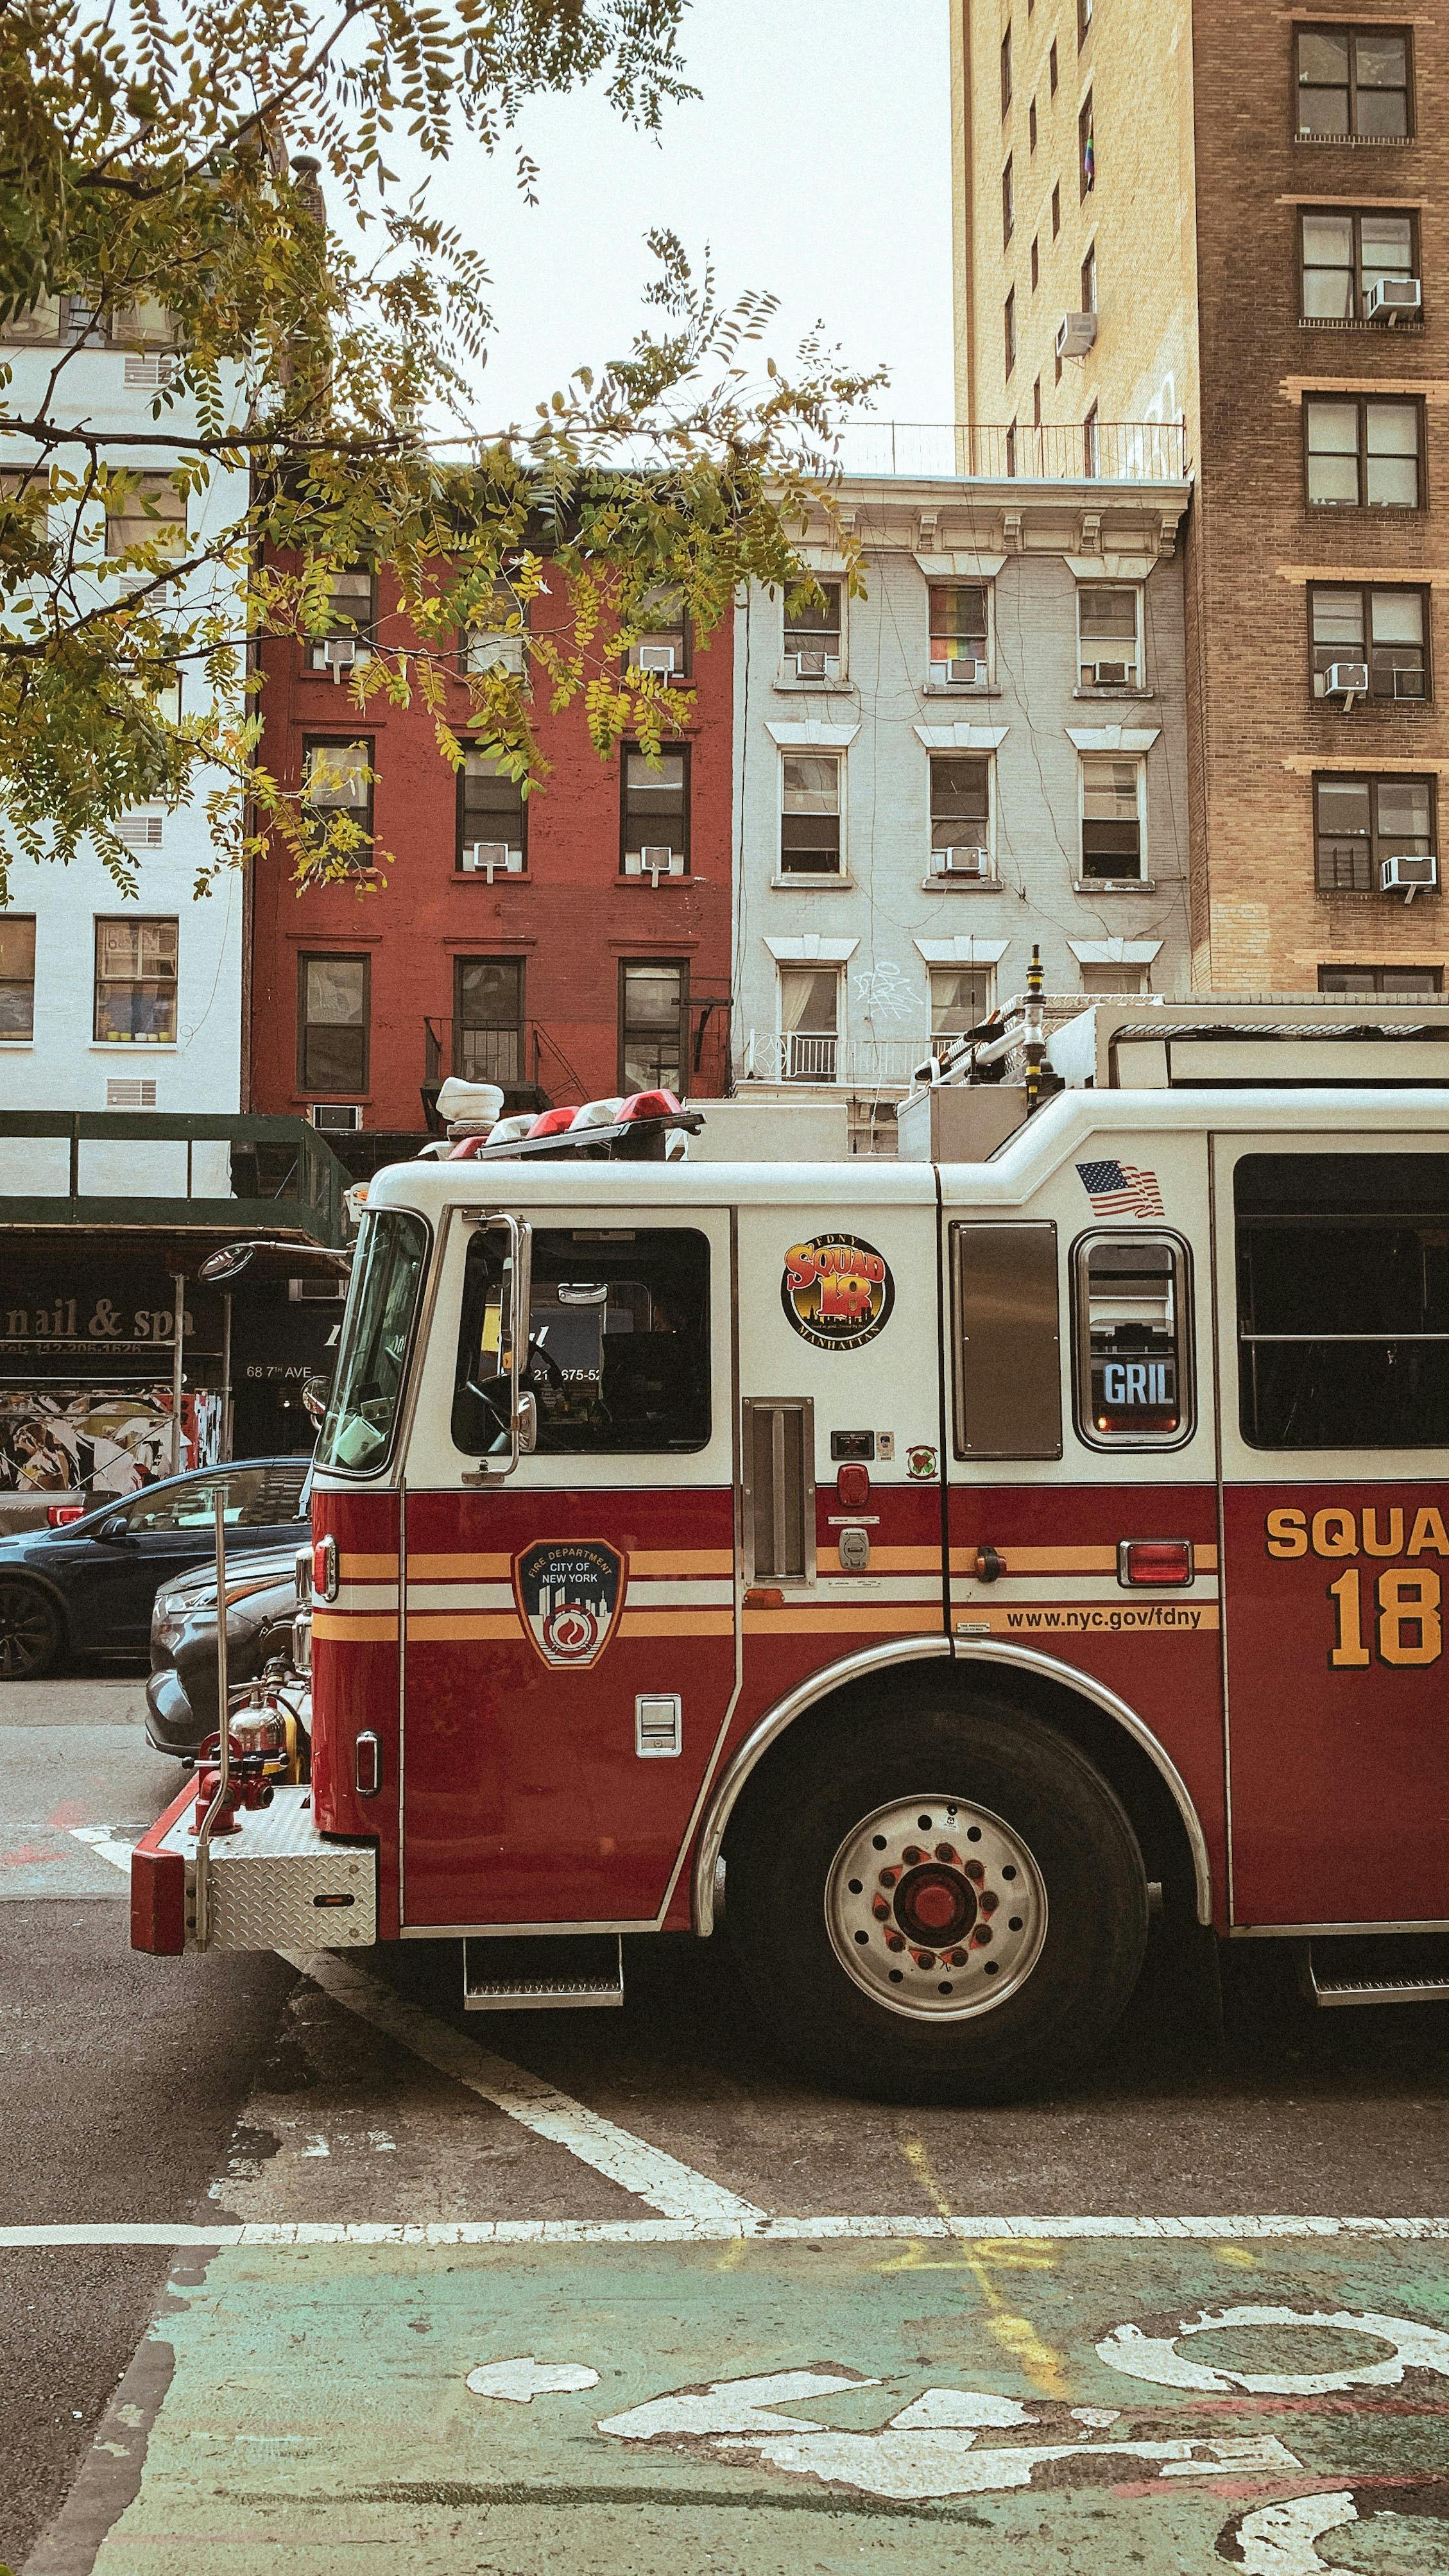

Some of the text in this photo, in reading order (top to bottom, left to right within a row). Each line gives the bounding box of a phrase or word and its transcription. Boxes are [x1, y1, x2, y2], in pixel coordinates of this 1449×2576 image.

[816, 1234, 859, 1247] FDNY
[784, 1243, 886, 1292] SQUAD
[816, 1273, 873, 1319] 18
[6, 1298, 196, 1342] nail & spa
[798, 1325, 880, 1350] MANHATTAN
[246, 1366, 313, 1378] 68 7TH AVE
[1265, 1507, 1449, 1558] SQUA
[528, 1547, 613, 1578] FIRE DEPARTMENT
[550, 1562, 590, 1572] CITY OF
[542, 1573, 598, 1583] NEW YORK
[1007, 1607, 1202, 1630] www.nyc.gov/fdny
[1328, 1568, 1443, 1668] 18
